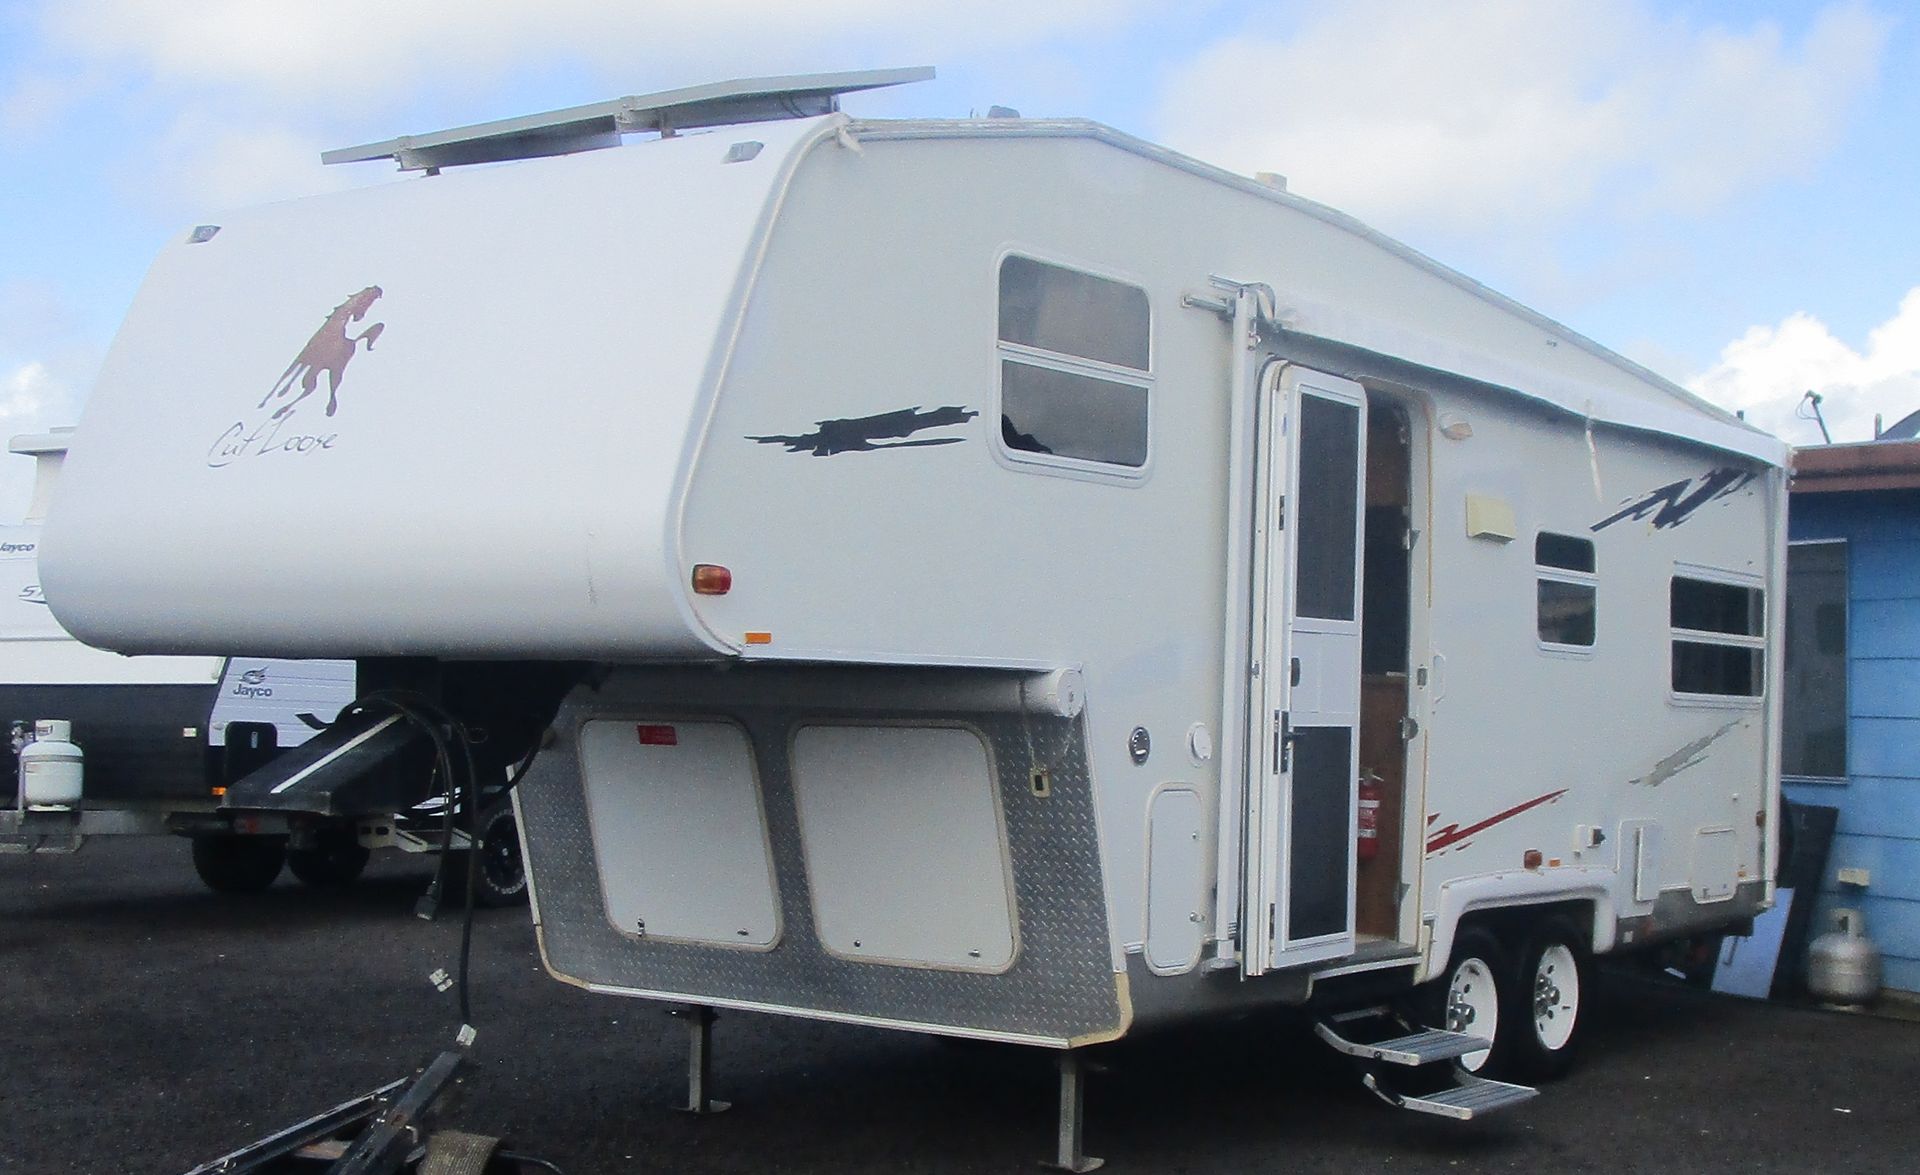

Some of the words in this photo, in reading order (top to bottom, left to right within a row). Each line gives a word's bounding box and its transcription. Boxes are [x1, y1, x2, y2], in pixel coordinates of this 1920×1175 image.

[208, 421, 266, 467] Cut
[256, 410, 338, 455] Loose
[233, 684, 273, 698] Jayco
